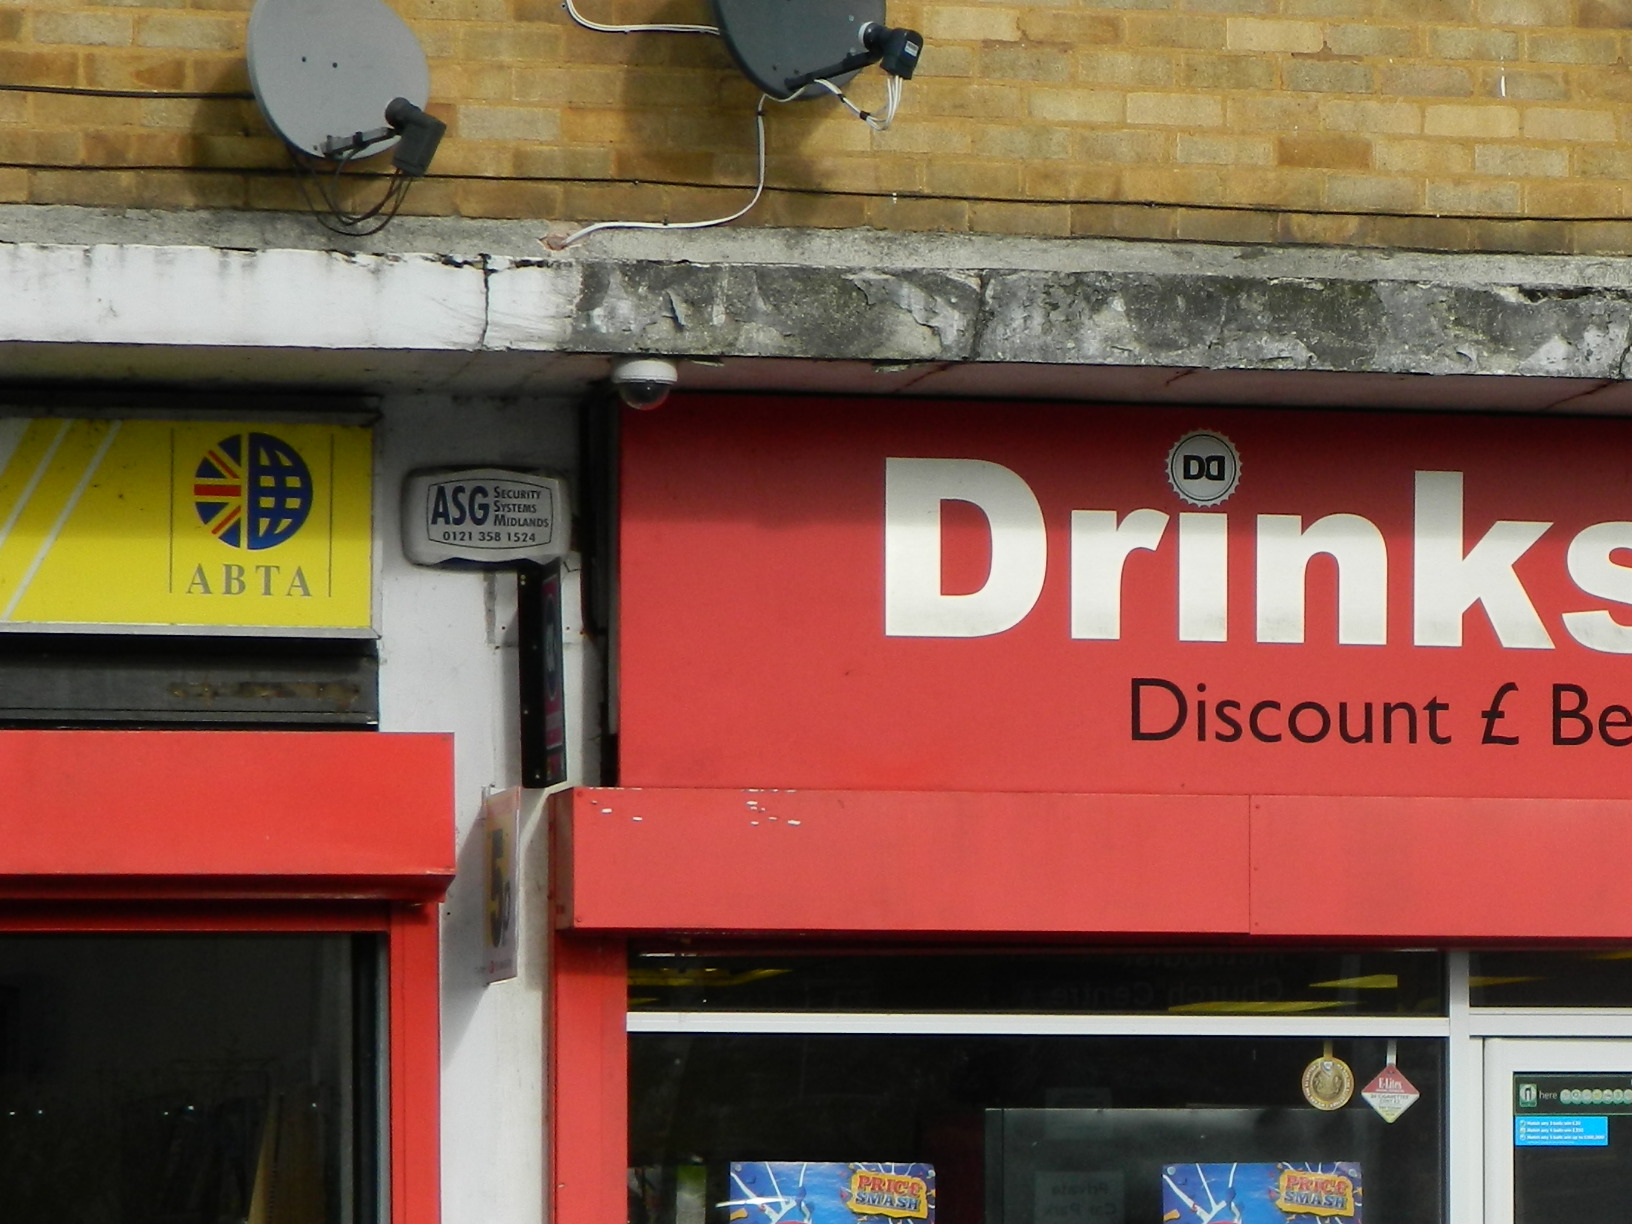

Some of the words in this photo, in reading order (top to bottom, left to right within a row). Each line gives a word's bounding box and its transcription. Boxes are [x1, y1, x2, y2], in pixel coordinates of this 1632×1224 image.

[431, 485, 491, 526] ASG
[493, 486, 542, 500] SECURITY
[493, 500, 537, 513] SYSTEMS
[493, 514, 549, 528] MIDLANDS
[443, 531, 473, 542] 0121
[478, 531, 502, 542] 358
[506, 532, 536, 543] 1524
[185, 563, 312, 598] ABTA
[1130, 678, 1450, 746] Discount
[1481, 682, 1520, 746] £
[1539, 1090, 1558, 1100] here
[857, 1174, 922, 1197] PRICE
[1286, 1174, 1349, 1196] PRICE
[855, 1192, 920, 1212] SMASH
[1284, 1190, 1347, 1210] SMASH
